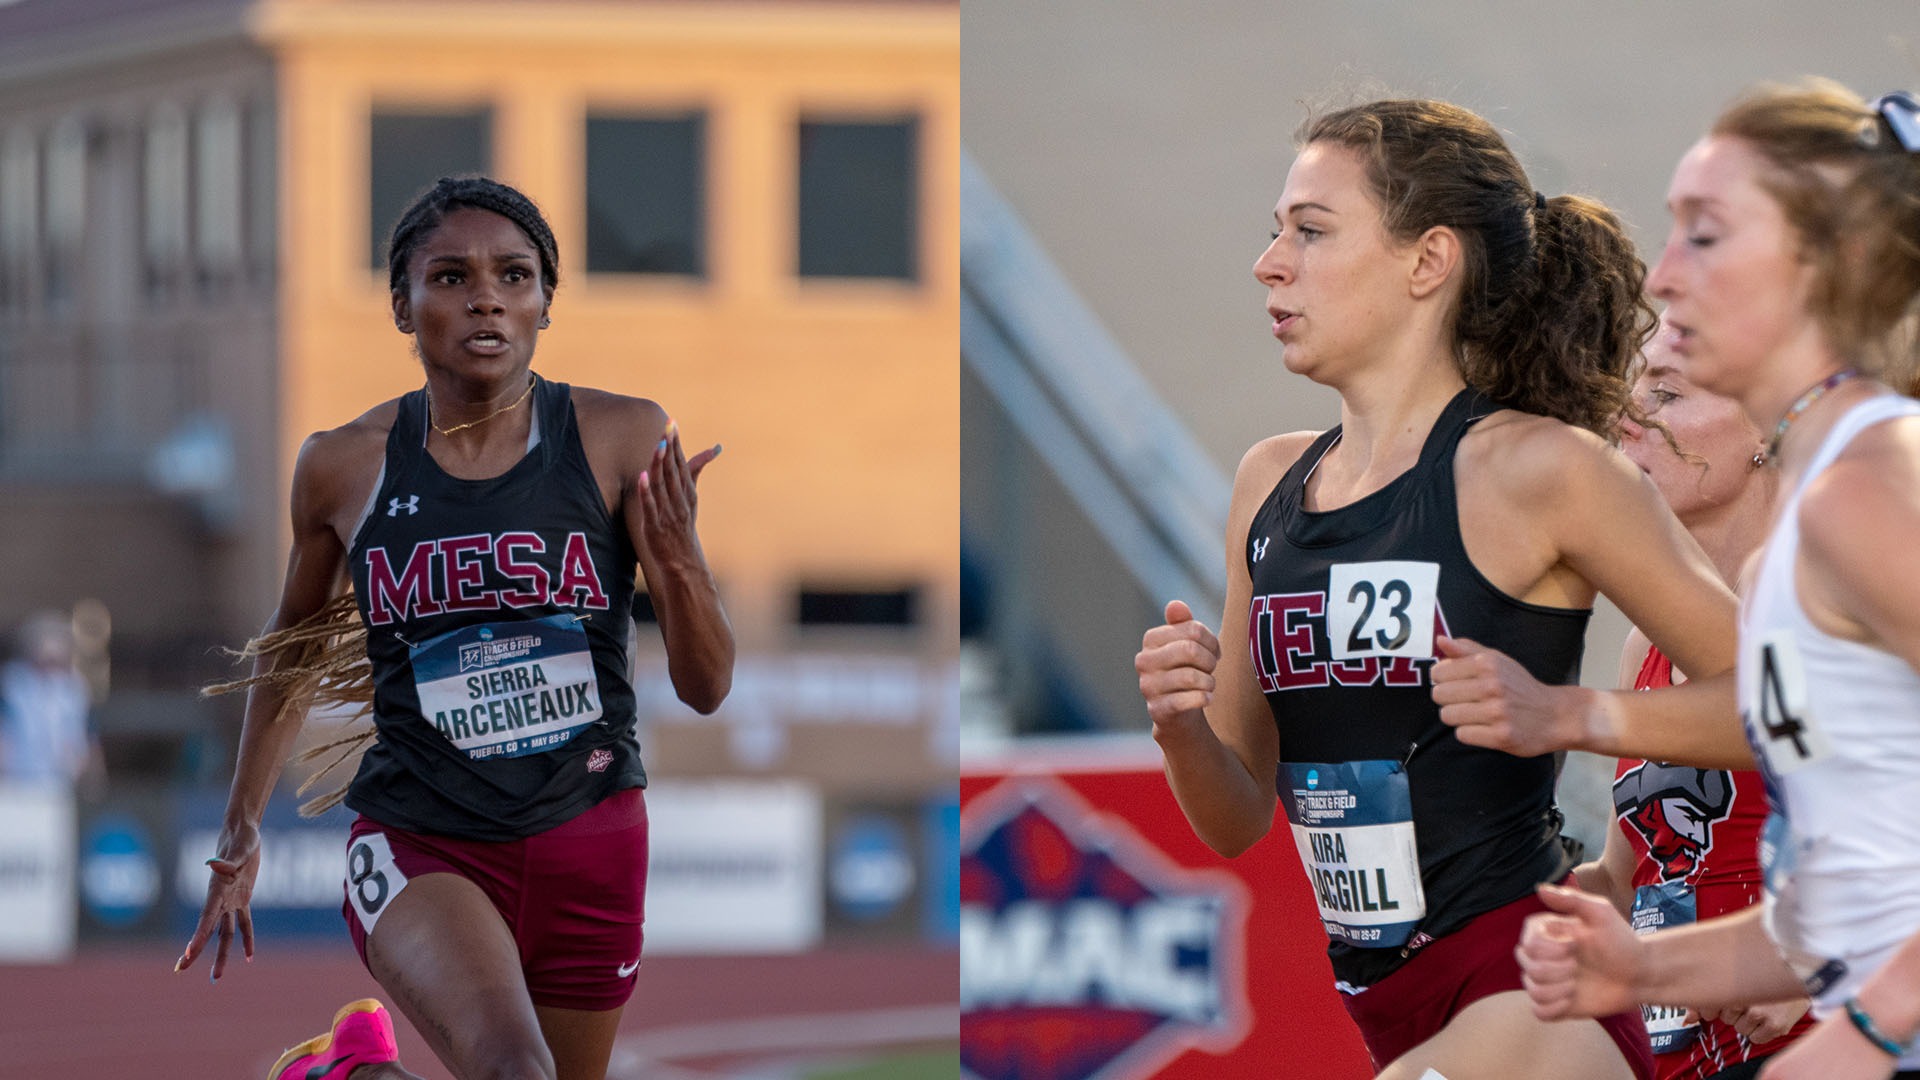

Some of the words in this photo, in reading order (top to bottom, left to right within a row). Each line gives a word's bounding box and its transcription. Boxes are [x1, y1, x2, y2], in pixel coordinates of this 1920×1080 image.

[366, 532, 610, 626] MESA
[1347, 579, 1412, 652] 23
[517, 637, 542, 650] FIELD
[466, 663, 548, 700] SIERRA
[1762, 643, 1812, 758] 4
[435, 681, 595, 741] ARCENEAUX
[469, 744, 504, 760] PUEBLO,
[506, 741, 518, 753] CO
[531, 736, 547, 748] MAY
[548, 731, 571, 744] 25-27
[1333, 795, 1356, 809] FIELD
[1309, 832, 1347, 864] KIRA
[349, 842, 389, 915] 8
